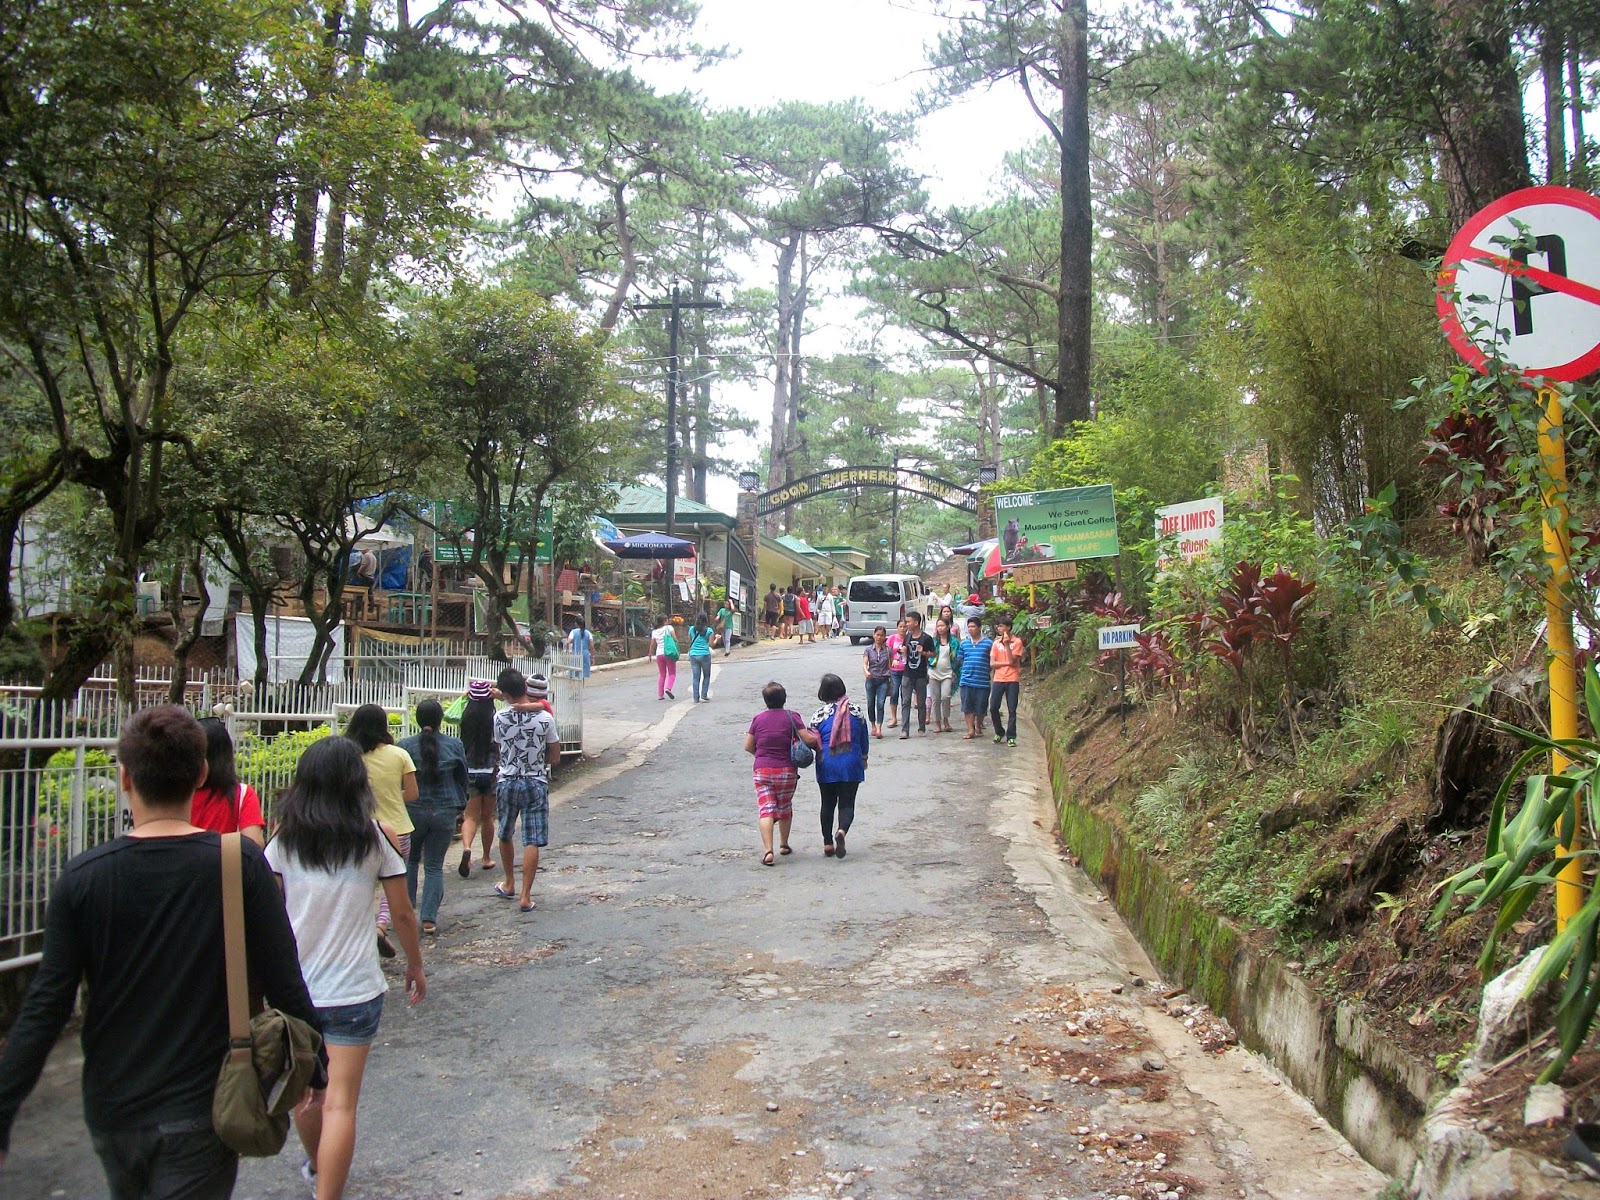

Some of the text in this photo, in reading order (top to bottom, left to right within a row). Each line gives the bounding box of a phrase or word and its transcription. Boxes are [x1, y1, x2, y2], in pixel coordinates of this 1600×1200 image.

[770, 481, 809, 504] GOOD
[821, 470, 897, 486] SHEPHERD
[996, 494, 1034, 509] WELCOME
[1048, 509, 1089, 519] We Serve
[1024, 522, 1058, 531] Musang
[1064, 518, 1086, 527] Civet
[1087, 516, 1115, 525] Coffee
[1161, 509, 1216, 535] OFF LIMITS
[1102, 631, 1110, 644] NO
